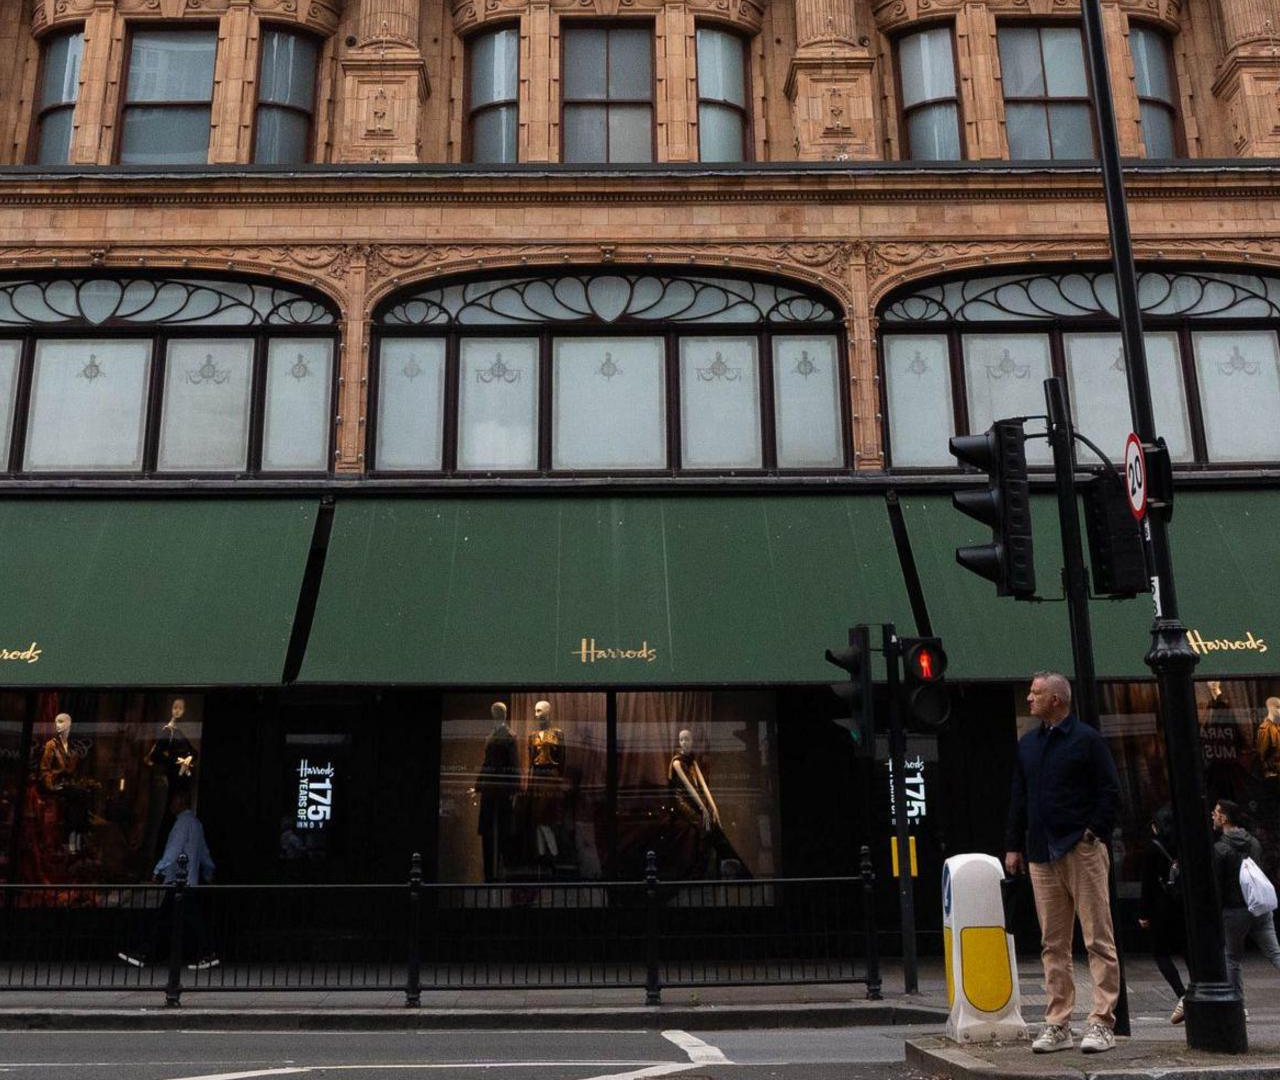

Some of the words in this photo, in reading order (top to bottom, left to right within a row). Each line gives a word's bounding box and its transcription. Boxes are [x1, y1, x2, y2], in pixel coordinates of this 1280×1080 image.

[1128, 455, 1142, 497] 20
[571, 638, 657, 663] Harrods
[1185, 629, 1268, 654] Harrods
[296, 758, 335, 777] Harrods
[884, 754, 924, 772] Hrods
[298, 778, 310, 807] YEARS
[307, 778, 332, 821] 175
[904, 772, 926, 817] 175
[297, 808, 307, 820] OF
